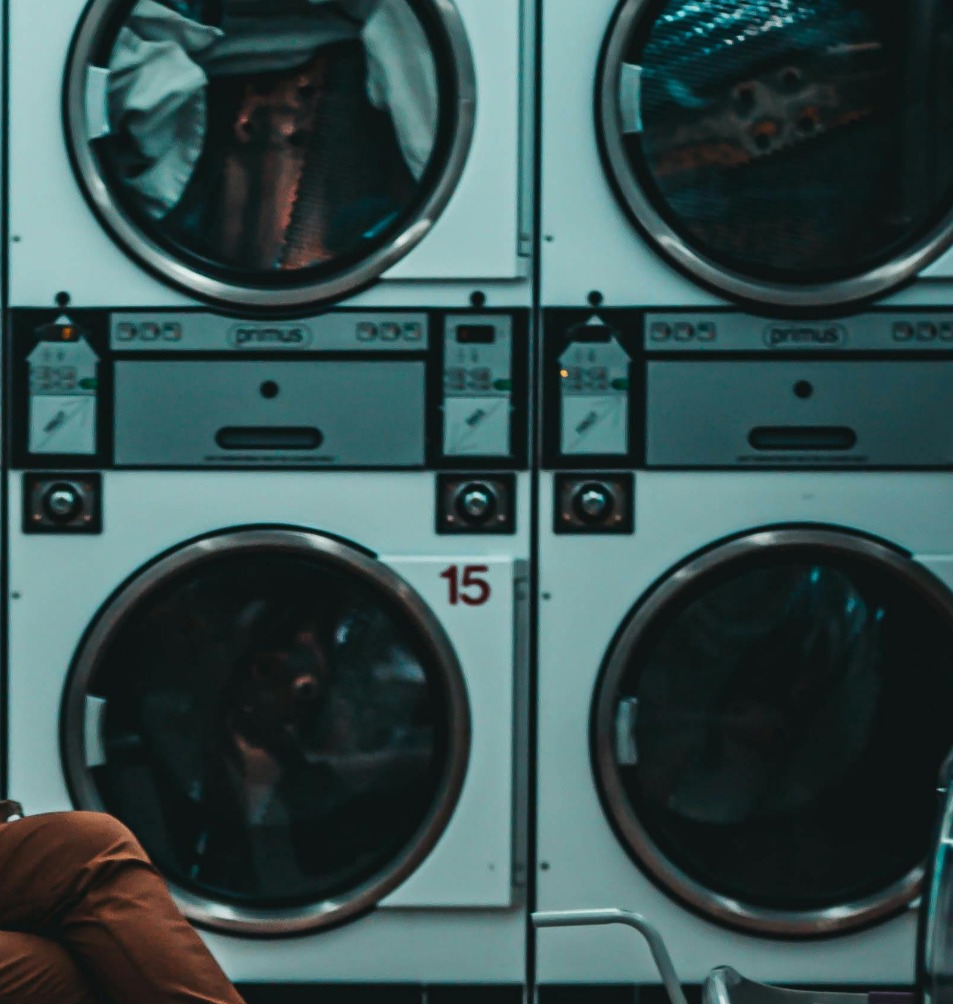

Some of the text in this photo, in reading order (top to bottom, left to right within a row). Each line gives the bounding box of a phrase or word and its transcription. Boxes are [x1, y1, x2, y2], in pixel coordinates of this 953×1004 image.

[235, 327, 304, 344] primus
[770, 327, 839, 345] primus
[439, 564, 491, 606] 15
